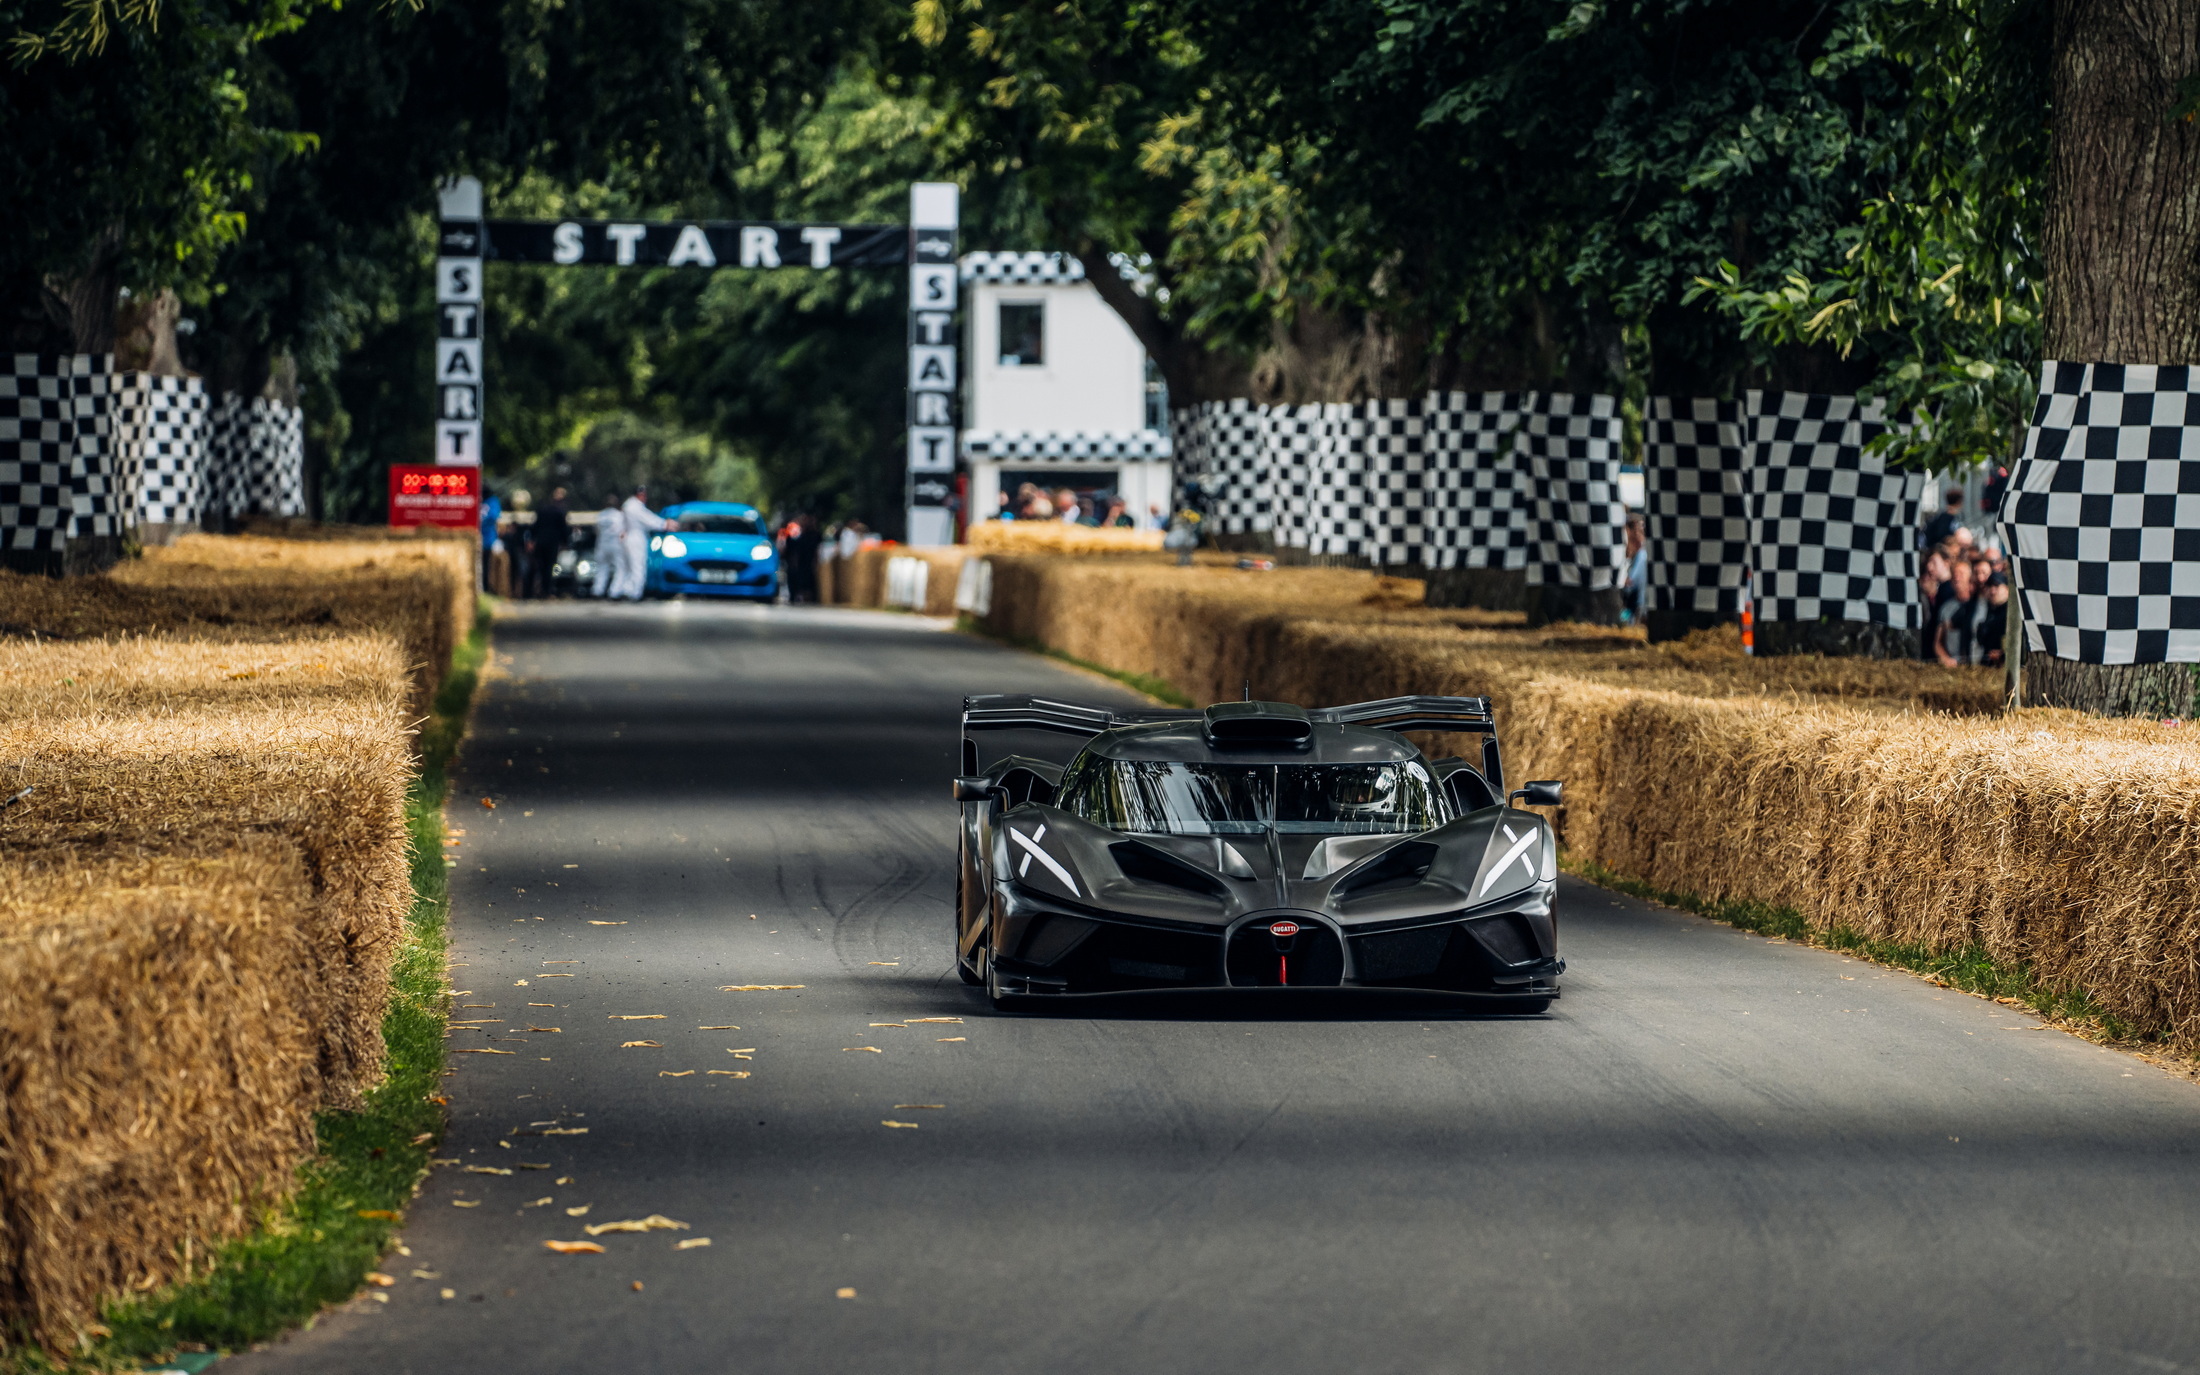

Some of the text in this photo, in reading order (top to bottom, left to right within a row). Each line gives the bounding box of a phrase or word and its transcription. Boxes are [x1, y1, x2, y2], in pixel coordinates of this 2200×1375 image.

[552, 222, 841, 269] START
[443, 266, 477, 456] START
[916, 275, 951, 462] START
